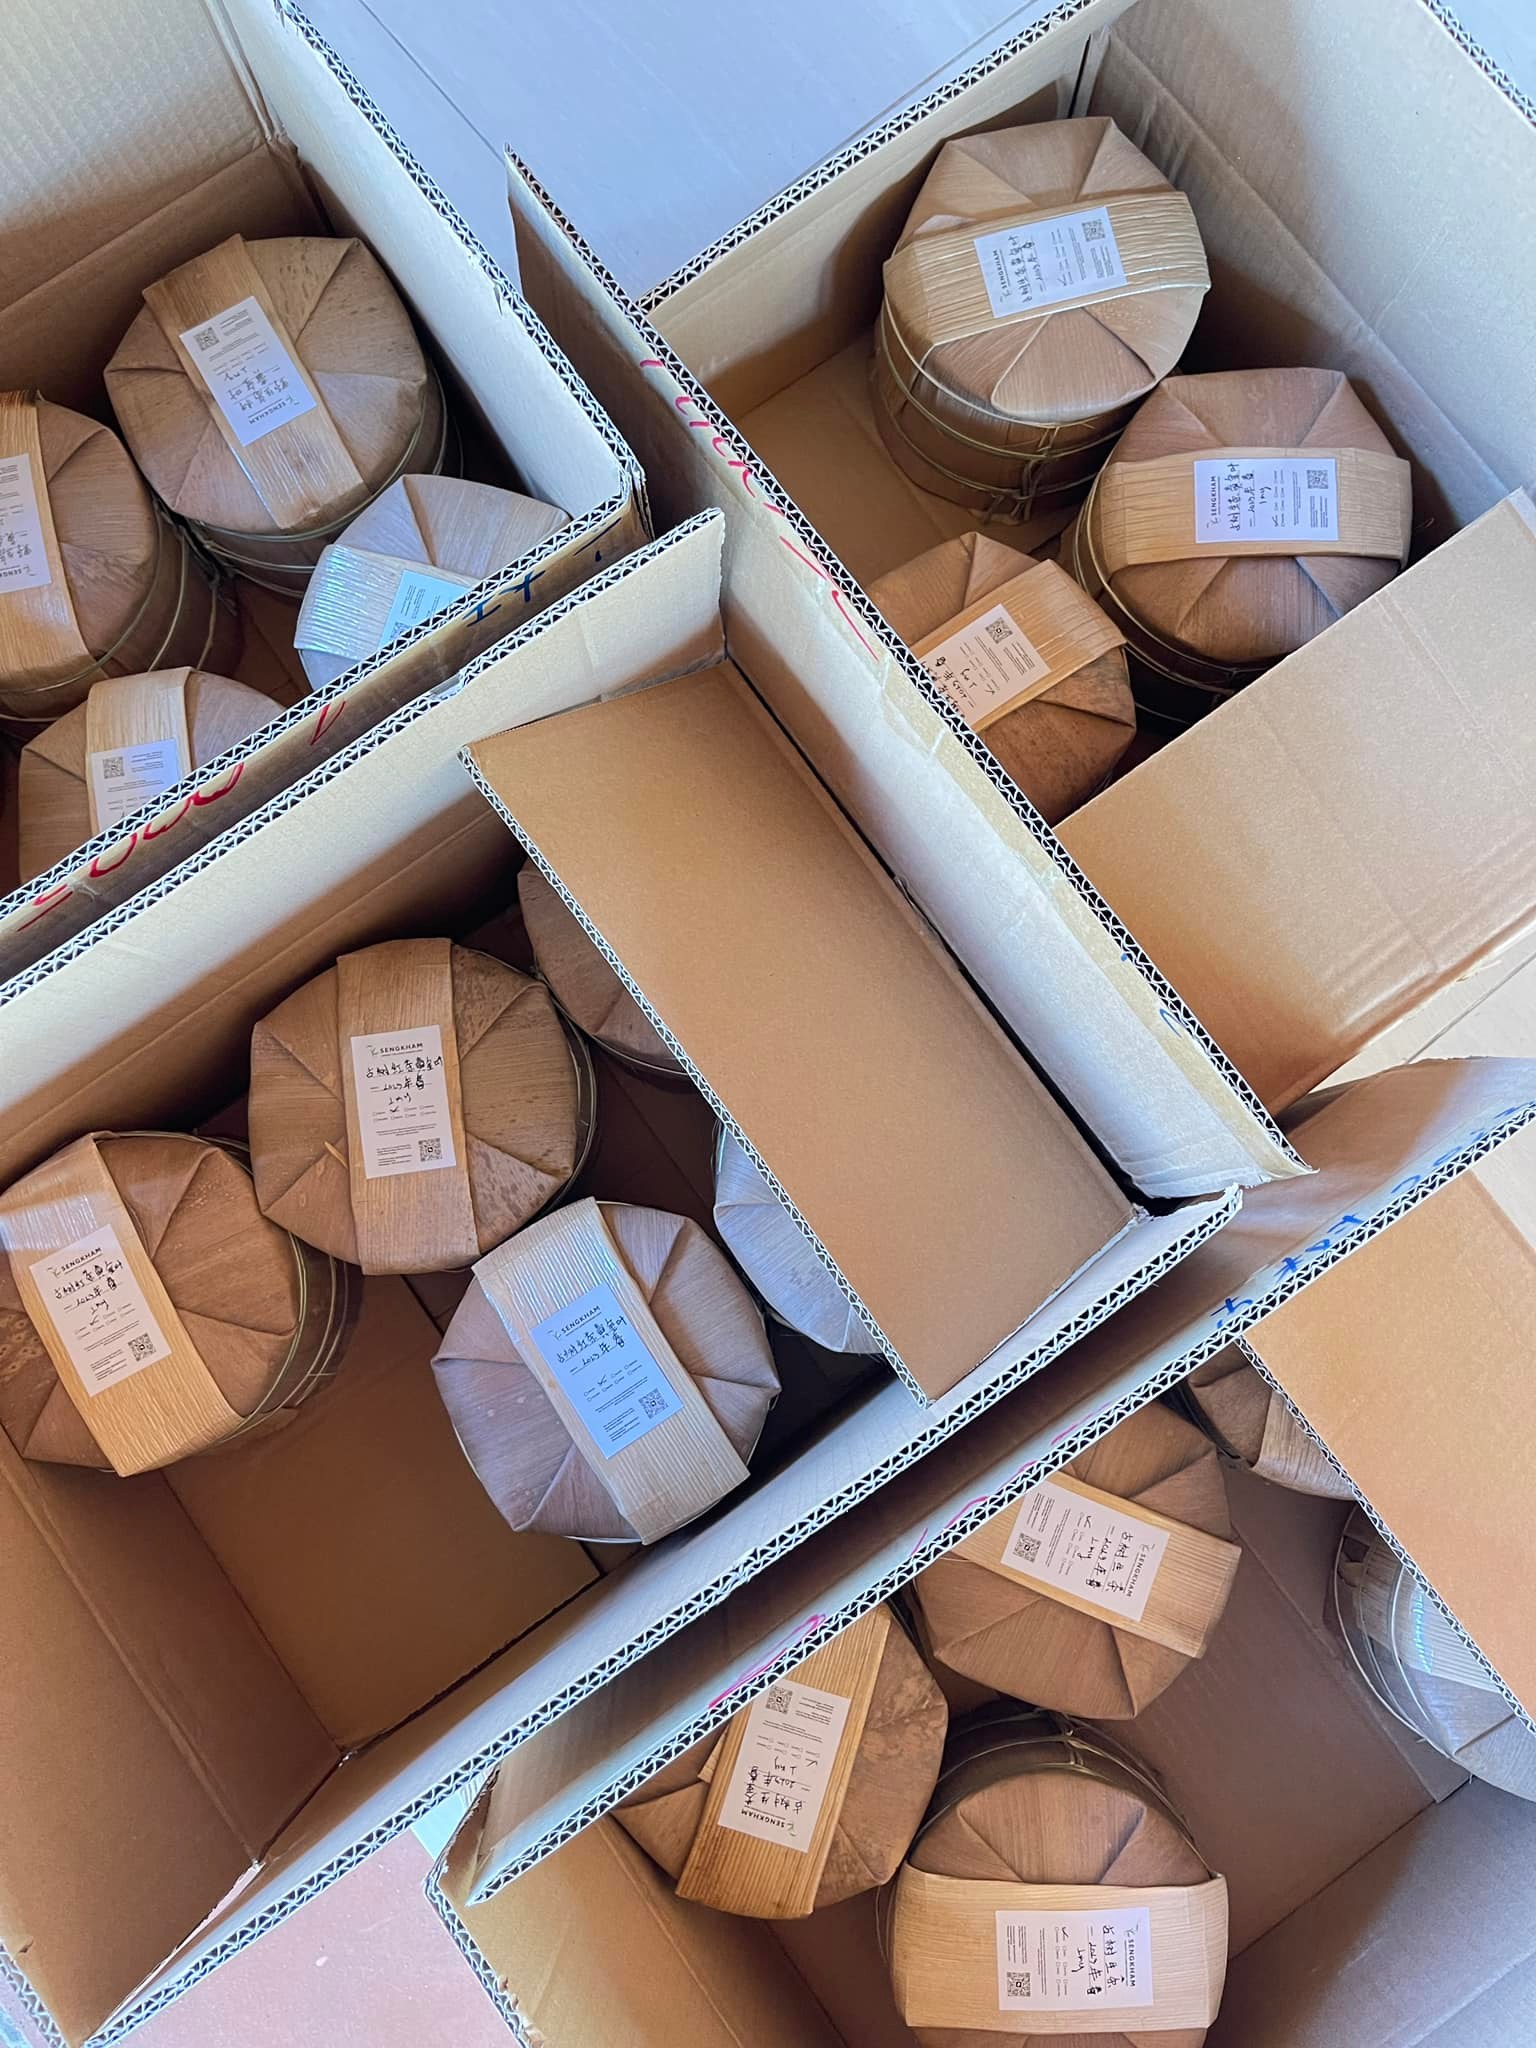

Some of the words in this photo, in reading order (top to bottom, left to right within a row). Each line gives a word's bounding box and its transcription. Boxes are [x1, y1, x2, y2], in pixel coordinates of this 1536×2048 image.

[1209, 475, 1217, 516] SENGKHAM
[379, 1042, 423, 1054] SENGKHAM
[60, 1246, 101, 1272] SENGKHAM
[560, 1304, 600, 1334] SENGKHAM
[1125, 1552, 1146, 1597] SENGKHAM
[740, 1808, 785, 1828] SENGKHAM
[1127, 1938, 1136, 1987] SENGKHAM
